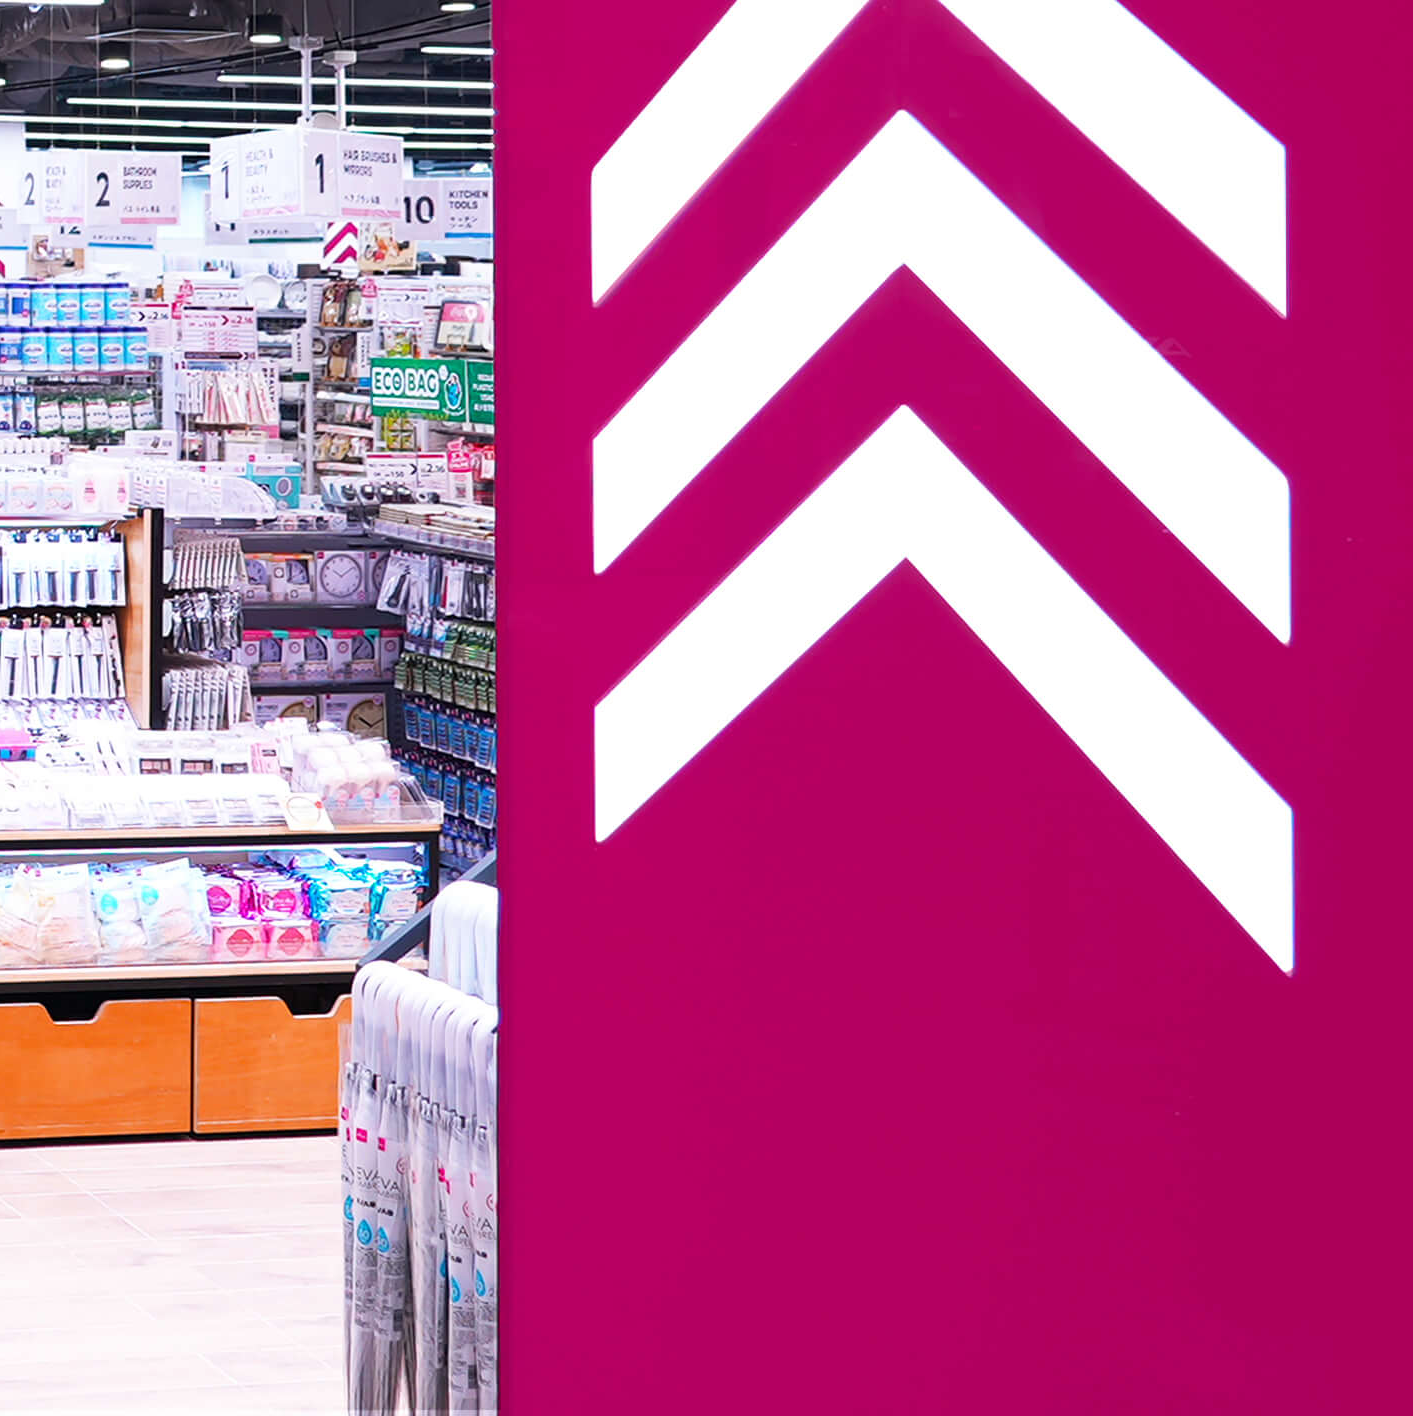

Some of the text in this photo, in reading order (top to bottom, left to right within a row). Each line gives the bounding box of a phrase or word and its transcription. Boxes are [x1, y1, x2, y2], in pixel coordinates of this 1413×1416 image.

[123, 166, 157, 177] BATHROOM
[123, 179, 153, 190] SUPPLIES
[221, 161, 229, 200] 1
[314, 153, 325, 194] 1
[24, 172, 35, 206] 2
[95, 171, 111, 208] 2
[449, 190, 488, 198] KITCHEN
[403, 196, 435, 224] 10
[449, 201, 478, 209] TOOLS
[373, 367, 404, 395] ECO
[406, 369, 440, 398] BAG
